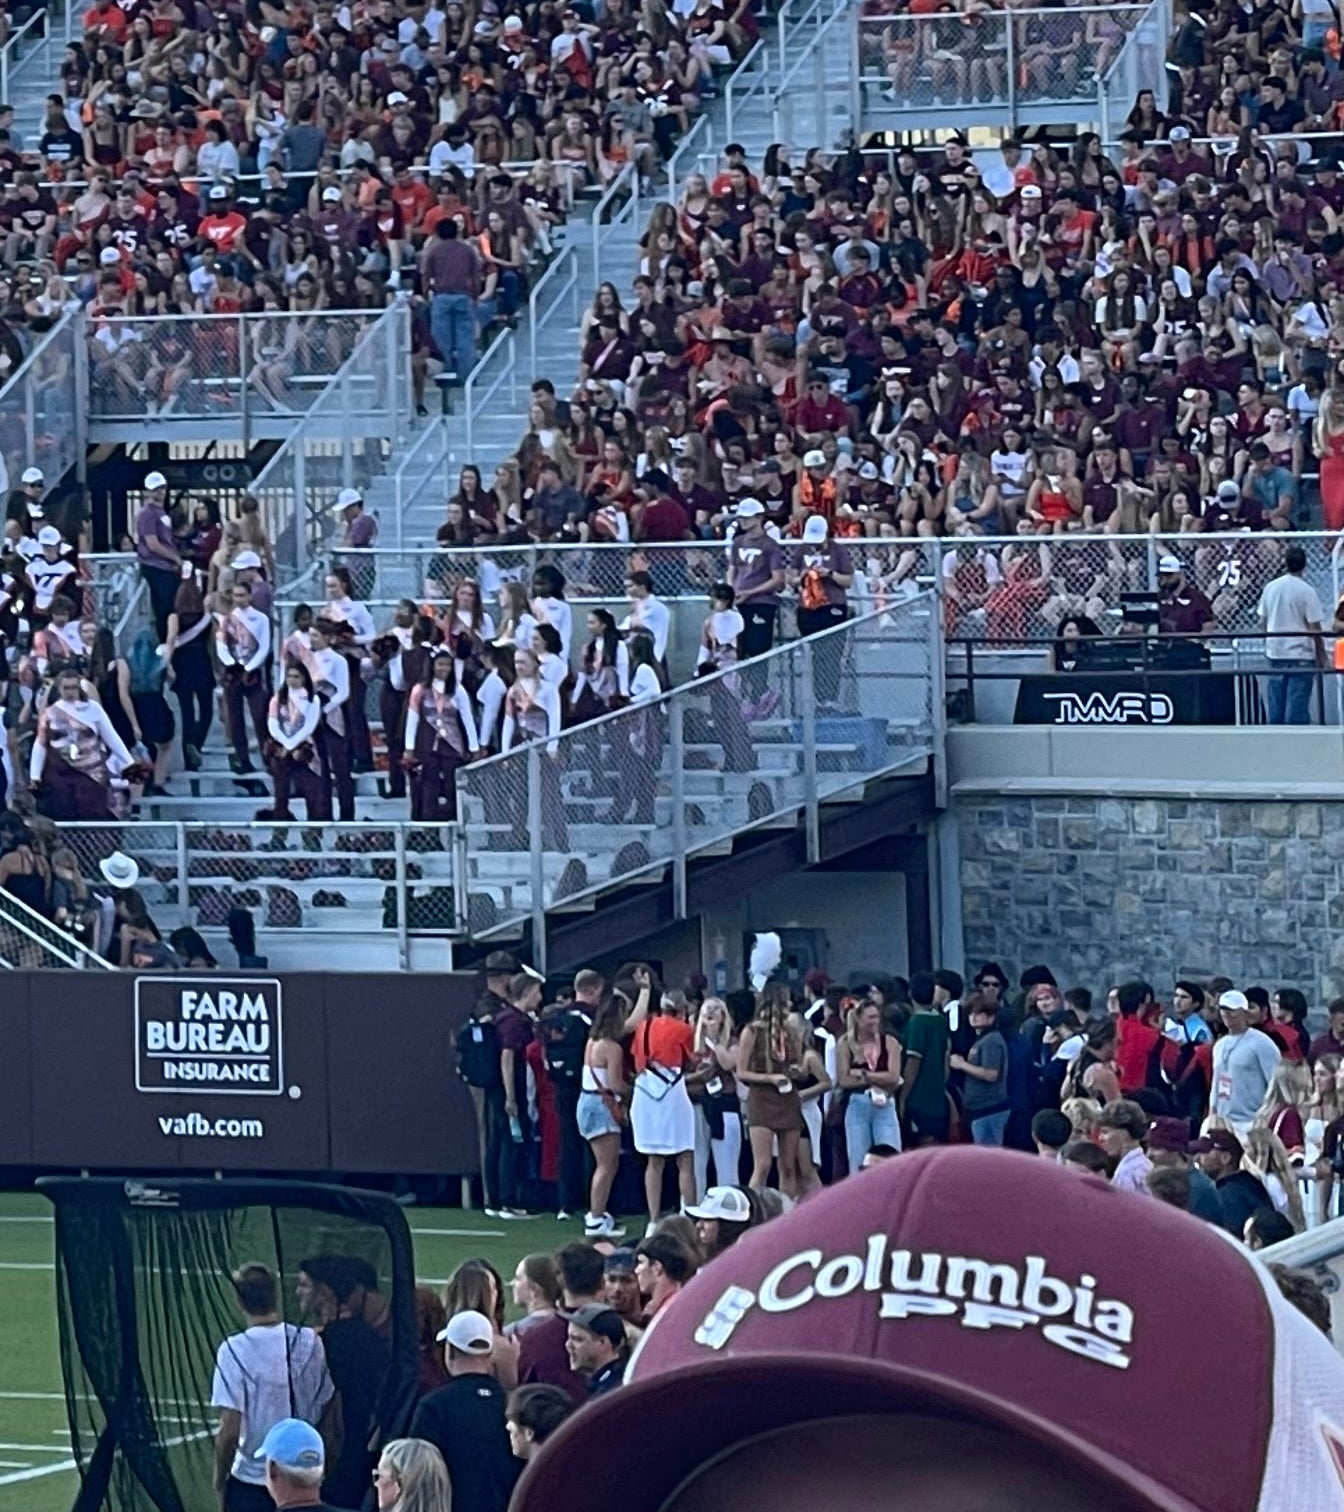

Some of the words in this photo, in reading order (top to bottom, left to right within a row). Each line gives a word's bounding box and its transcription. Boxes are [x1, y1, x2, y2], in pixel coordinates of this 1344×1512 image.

[180, 990, 269, 1021] FARM
[146, 1022, 270, 1053] BUREAU
[163, 1061, 271, 1083] INSURANCE
[158, 1112, 263, 1138] vafb.com
[758, 1232, 1135, 1344] Columbia
[878, 1292, 1131, 1370] PFG
